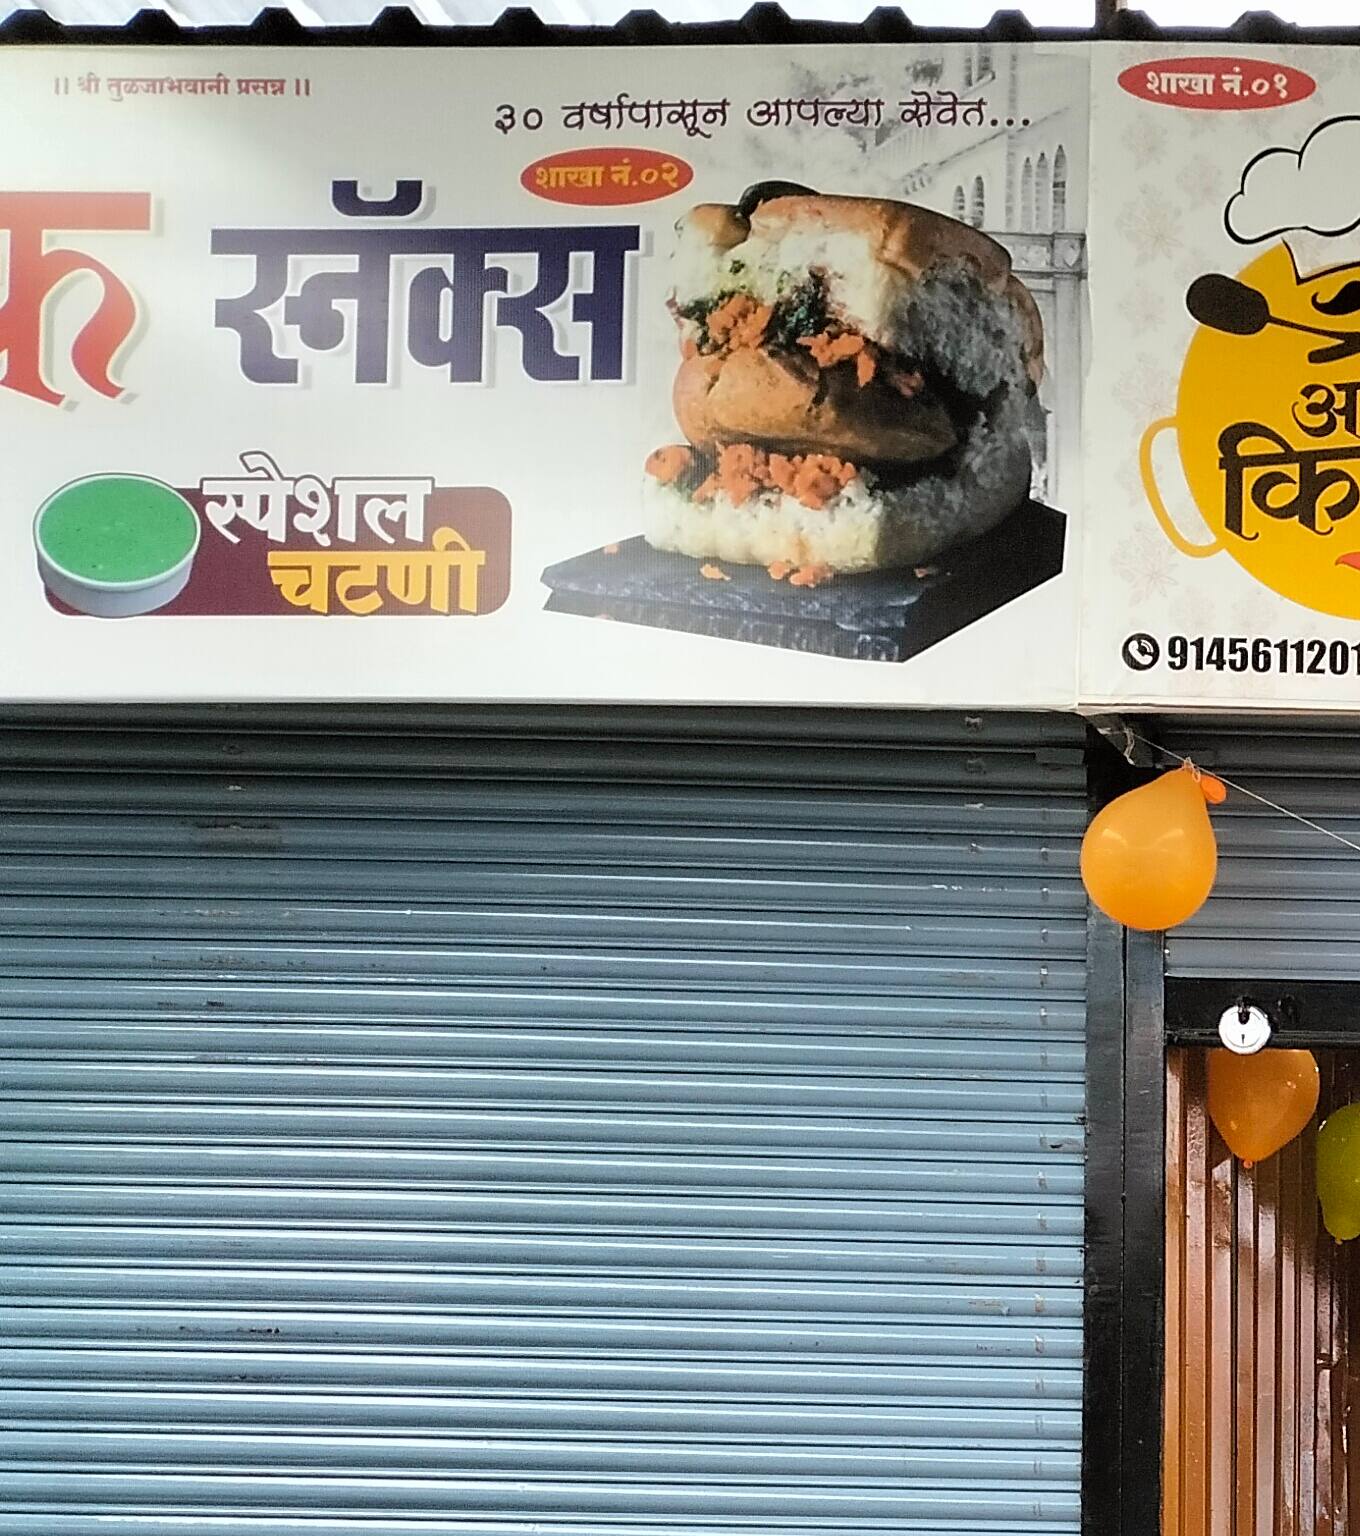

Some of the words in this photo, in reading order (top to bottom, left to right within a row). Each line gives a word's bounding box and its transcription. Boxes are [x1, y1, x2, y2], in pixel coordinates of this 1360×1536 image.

[77, 72, 101, 95] श्री
[107, 72, 229, 101] तुळजाभवानी
[237, 78, 285, 96] प्रसन्न
[1146, 71, 1215, 94] शाखा
[495, 103, 543, 134] ३०
[561, 93, 730, 139] वर्षापासून
[746, 98, 884, 128] आपल्या
[536, 166, 604, 189] शाखा
[210, 180, 640, 384] स्नॅक्स
[200, 450, 435, 547] स्पेशल
[267, 526, 485, 615] चटणी
